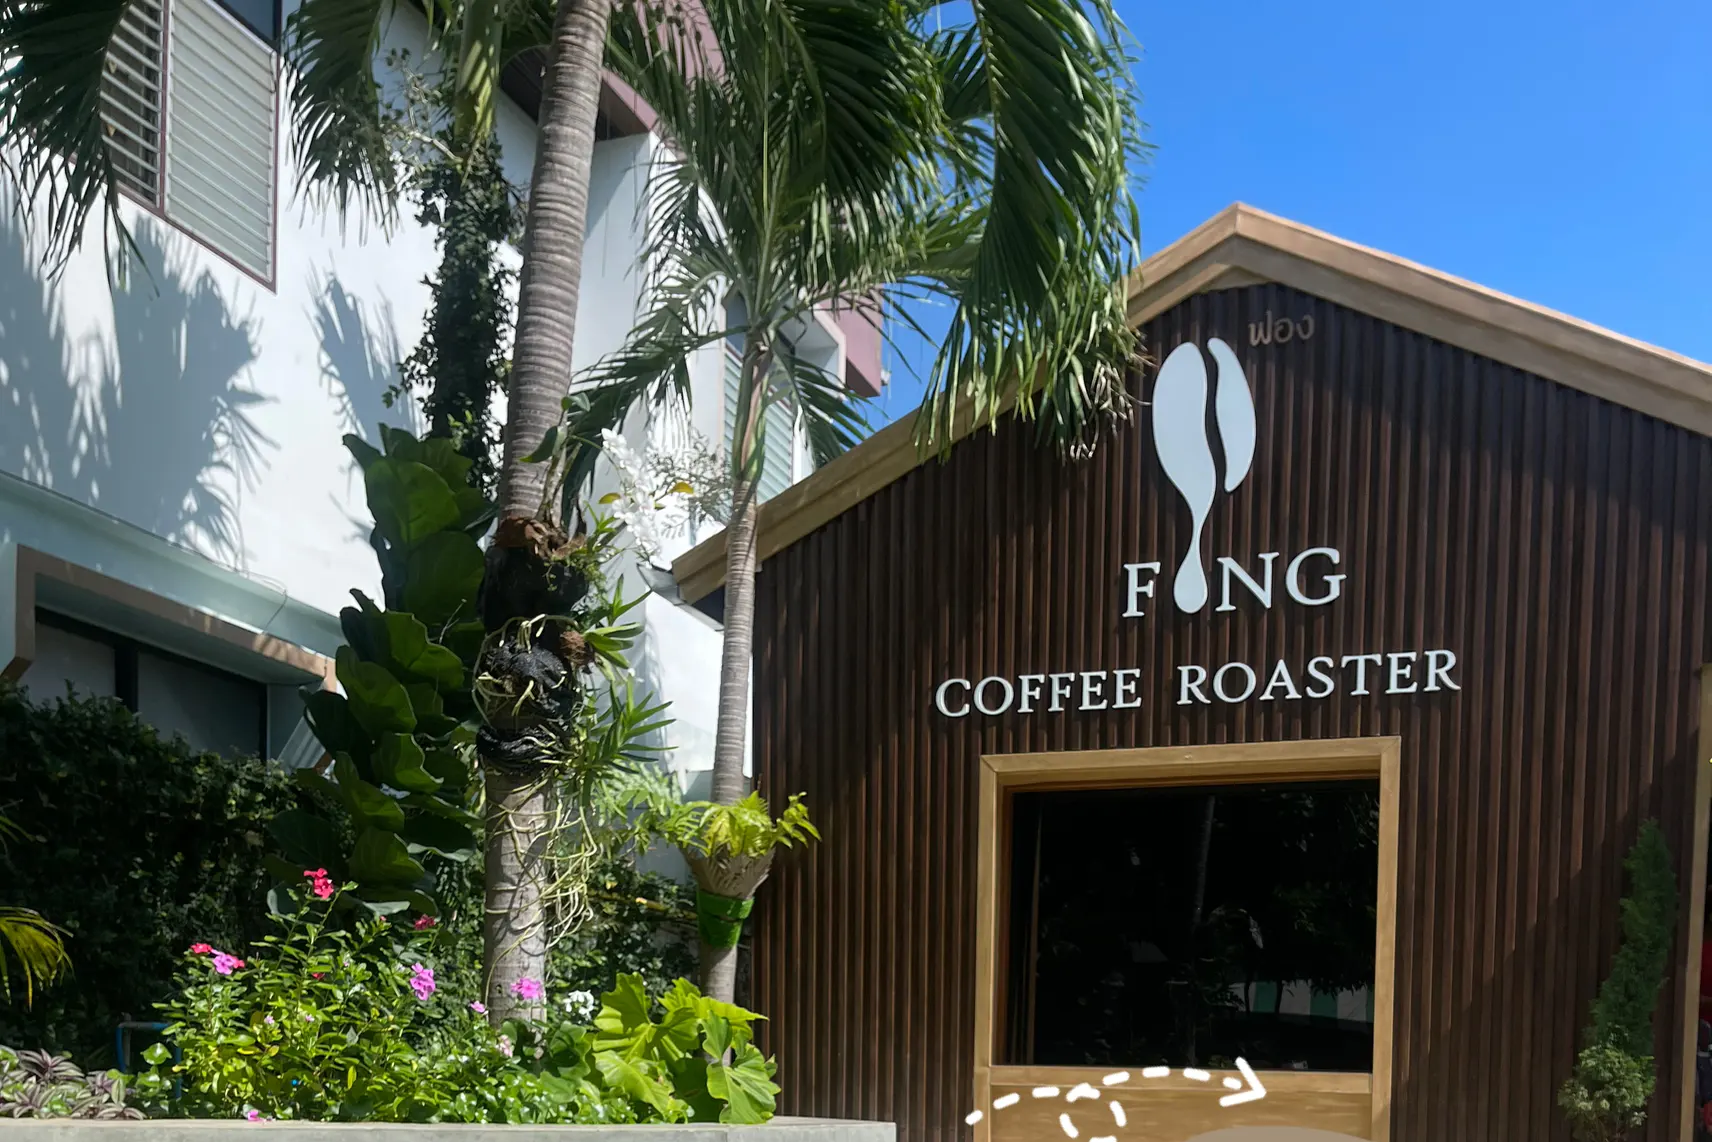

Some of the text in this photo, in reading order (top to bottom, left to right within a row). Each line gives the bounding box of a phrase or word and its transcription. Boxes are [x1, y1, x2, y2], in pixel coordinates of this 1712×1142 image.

[1248, 309, 1315, 347] ฟอง
[935, 648, 1461, 718] COFFEE ROASTER
